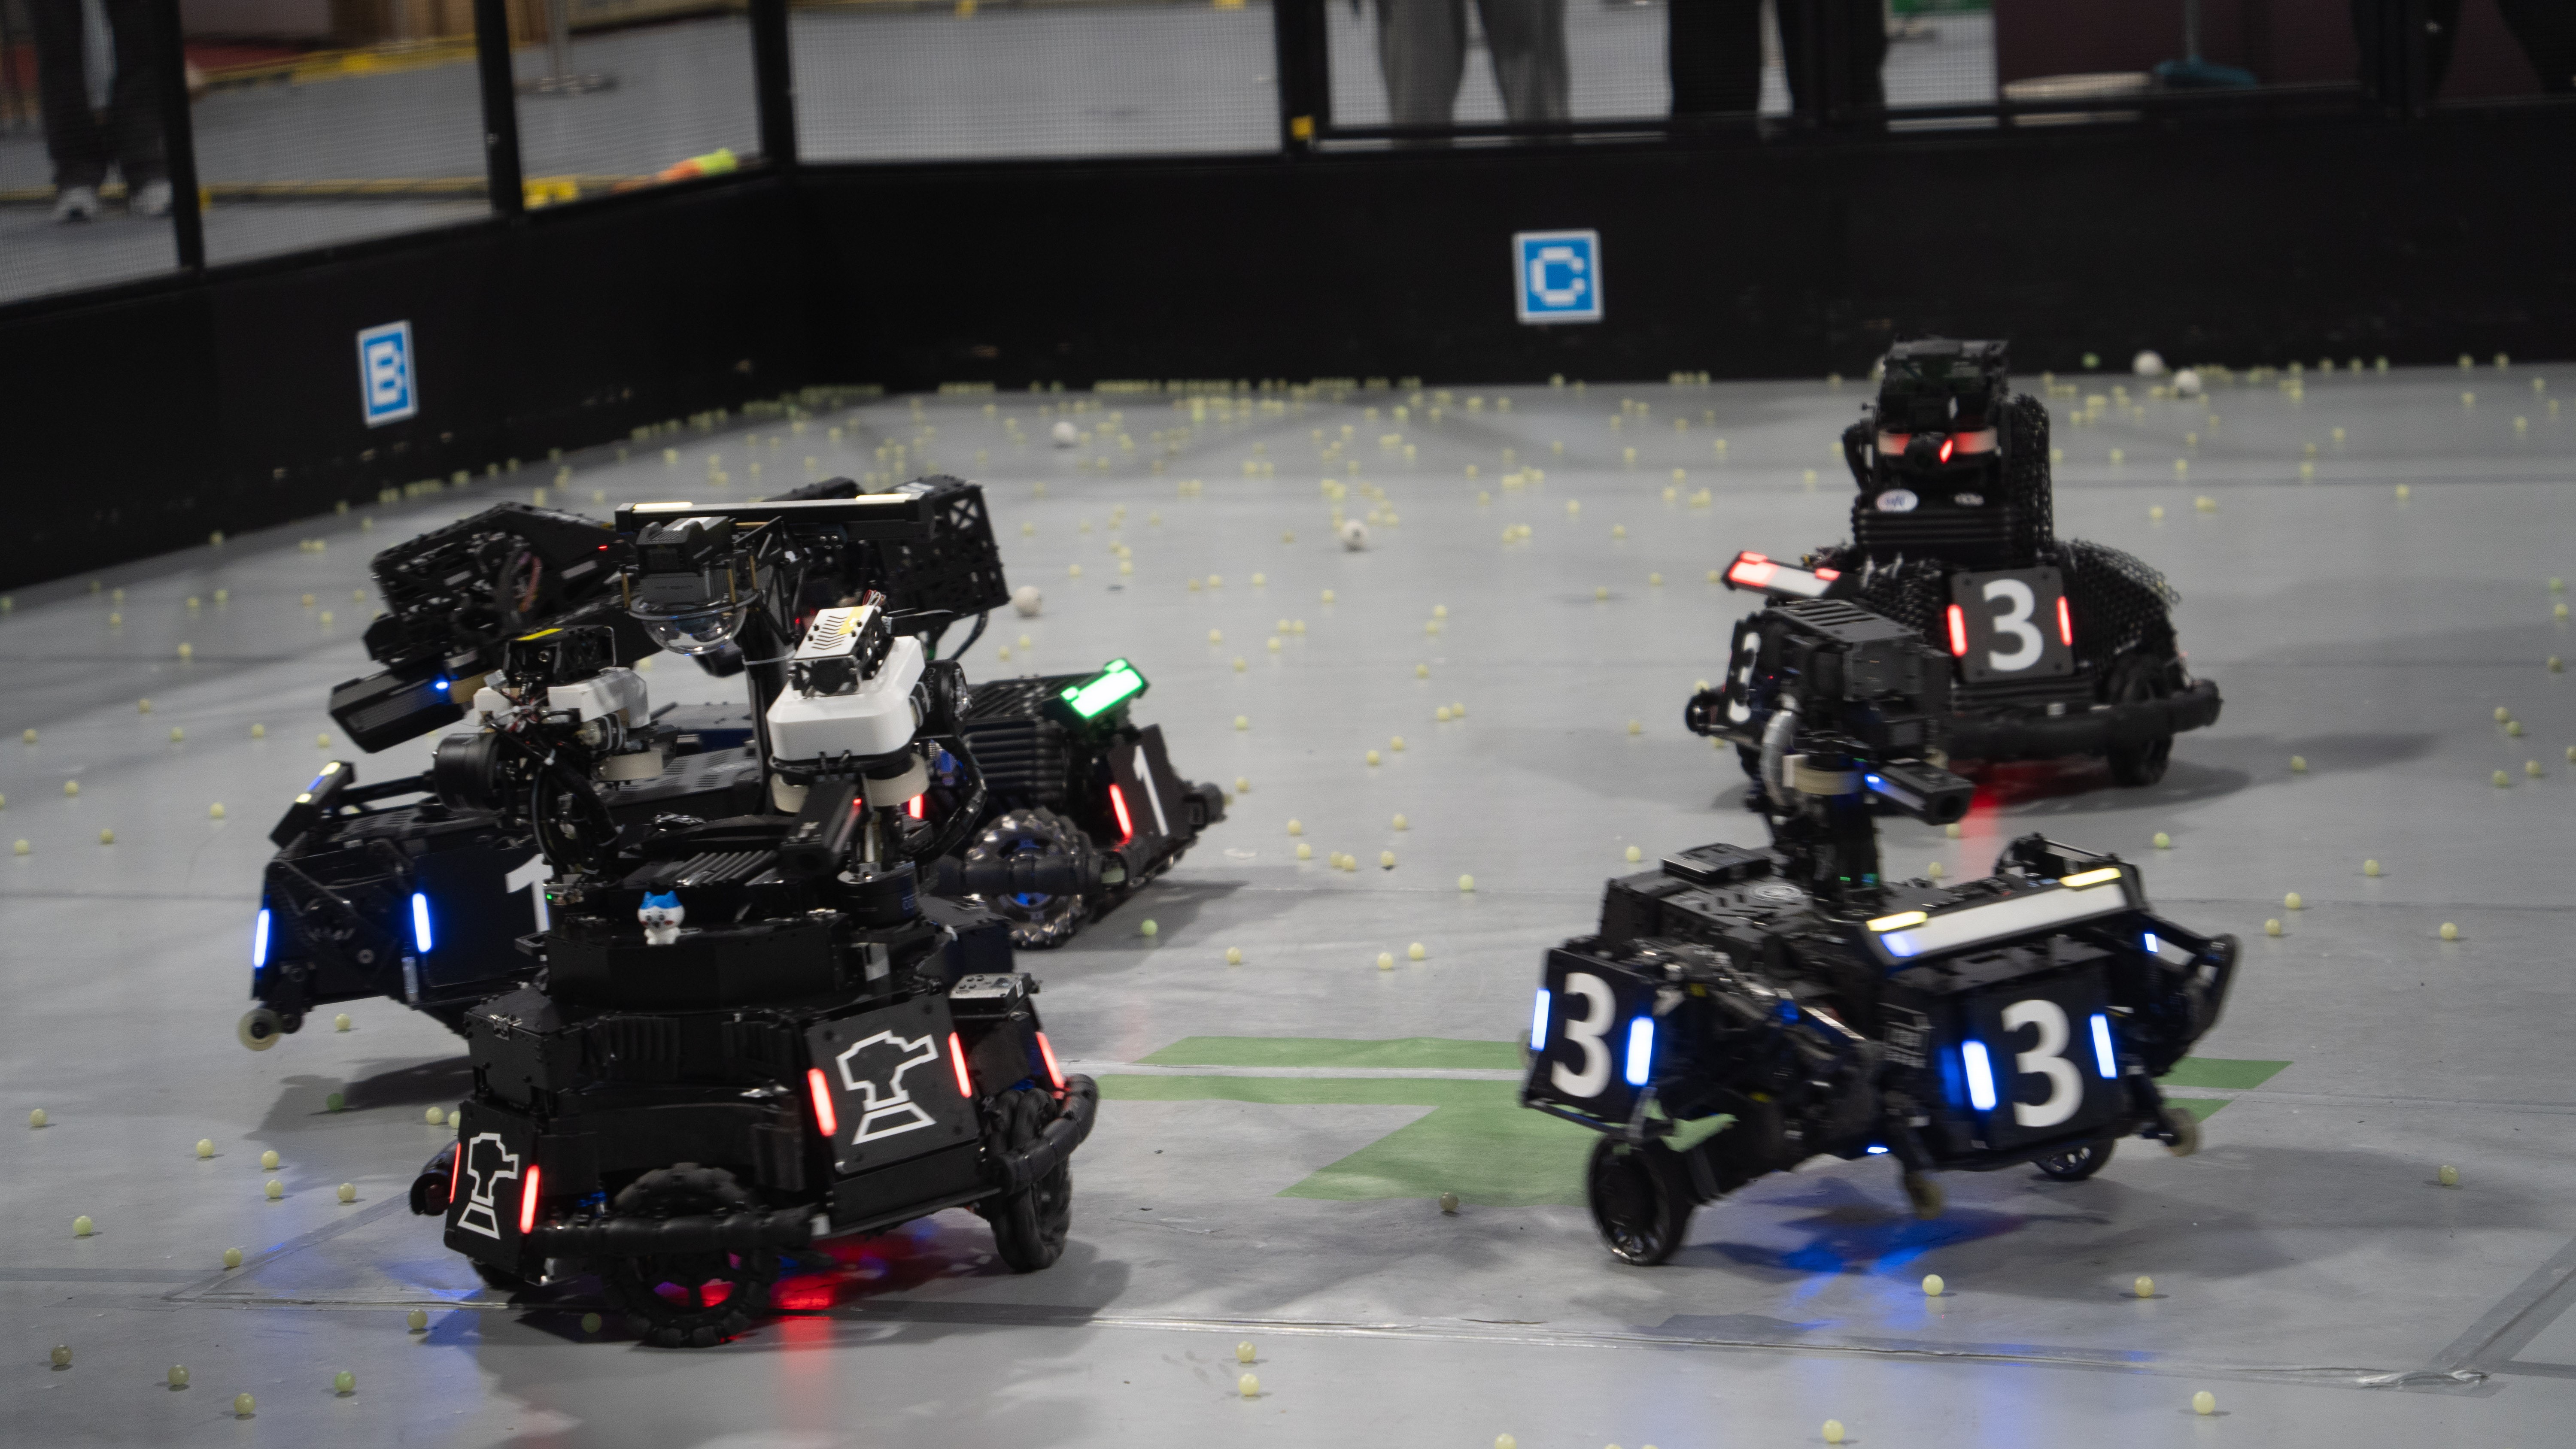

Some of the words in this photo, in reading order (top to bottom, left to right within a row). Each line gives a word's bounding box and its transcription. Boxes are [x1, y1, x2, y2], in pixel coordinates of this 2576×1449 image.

[1530, 247, 1585, 306] C
[370, 342, 403, 404] B
[1984, 579, 2043, 671] 3
[1133, 745, 1169, 836] 1
[504, 852, 555, 932] 1
[1552, 973, 1616, 1097] 3
[2001, 999, 2084, 1127] 3
